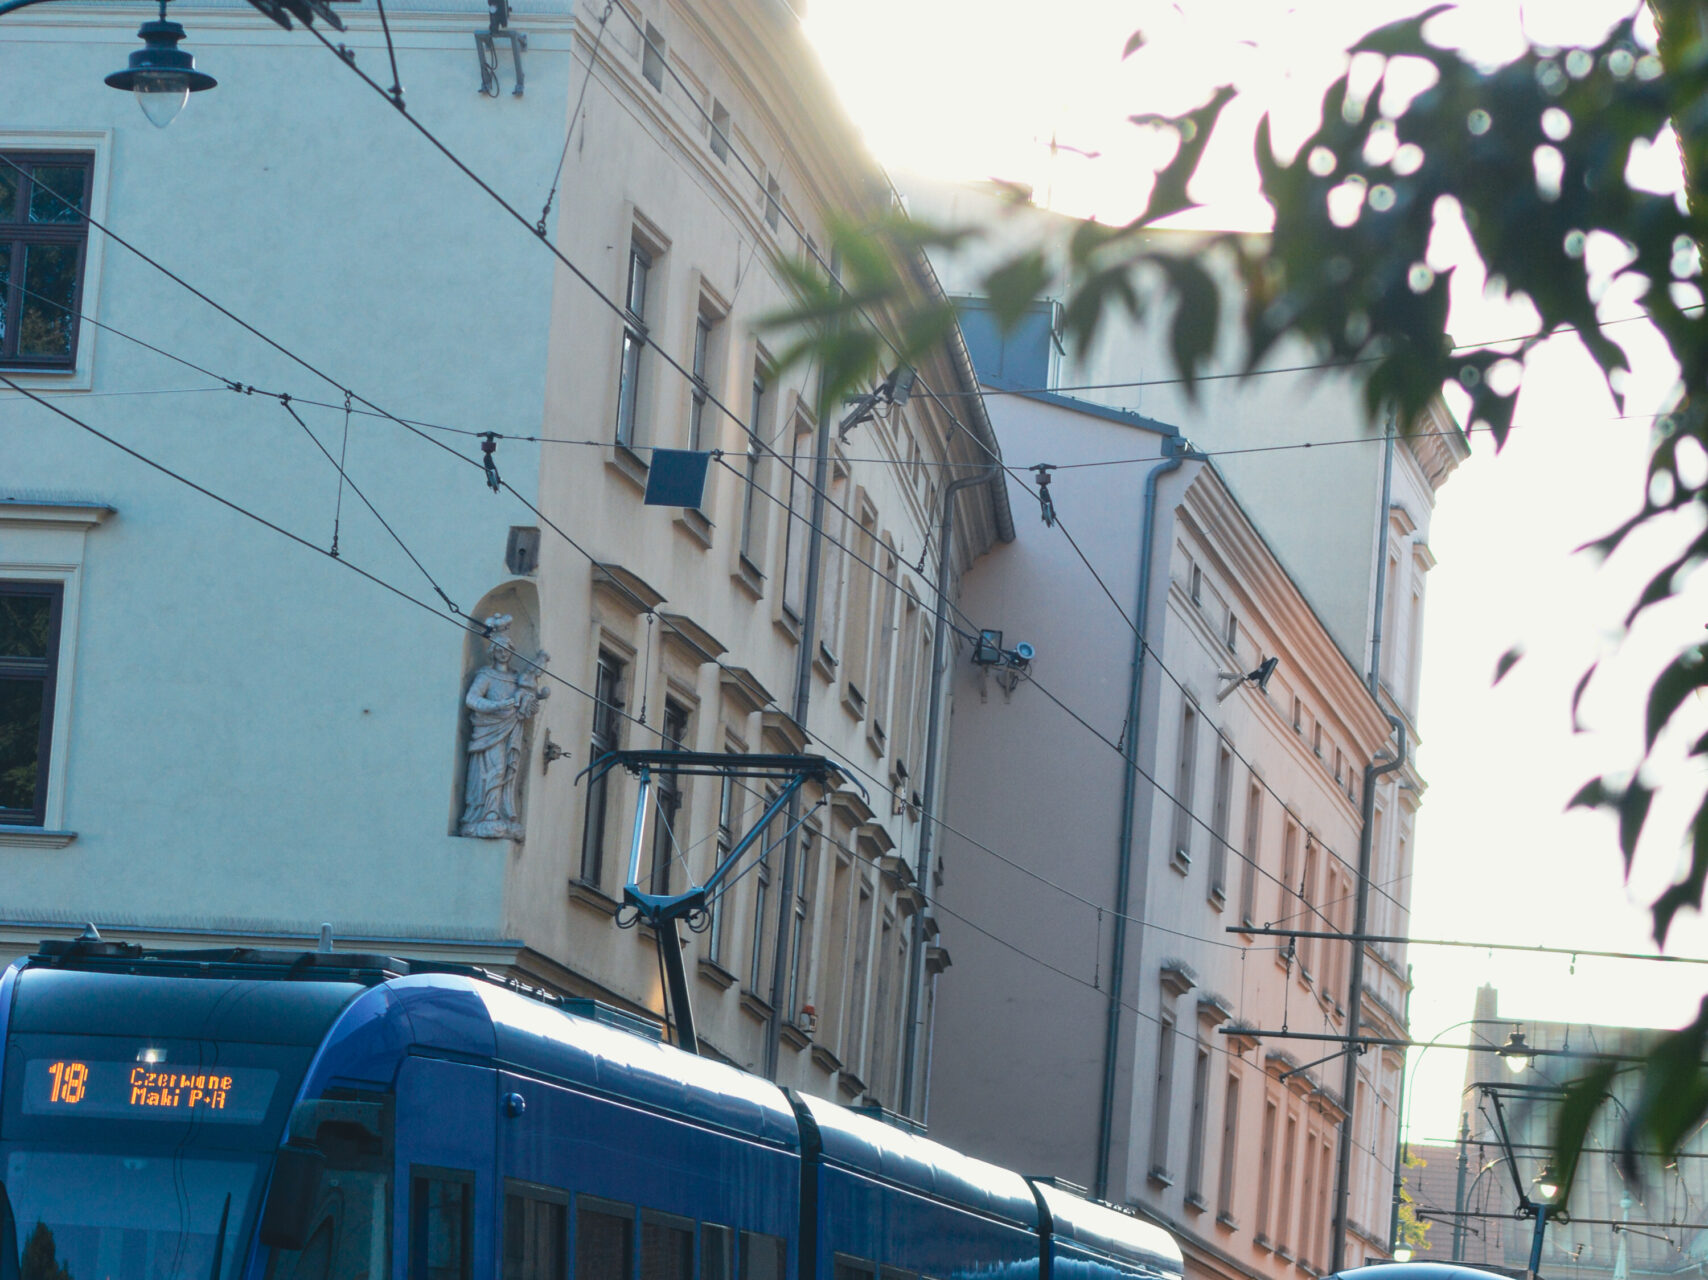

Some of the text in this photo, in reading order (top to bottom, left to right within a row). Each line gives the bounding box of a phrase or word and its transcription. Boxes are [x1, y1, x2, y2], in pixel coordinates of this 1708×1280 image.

[49, 1062, 88, 1103] 18
[130, 1067, 233, 1090] Czerwone
[130, 1086, 180, 1107] Maki
